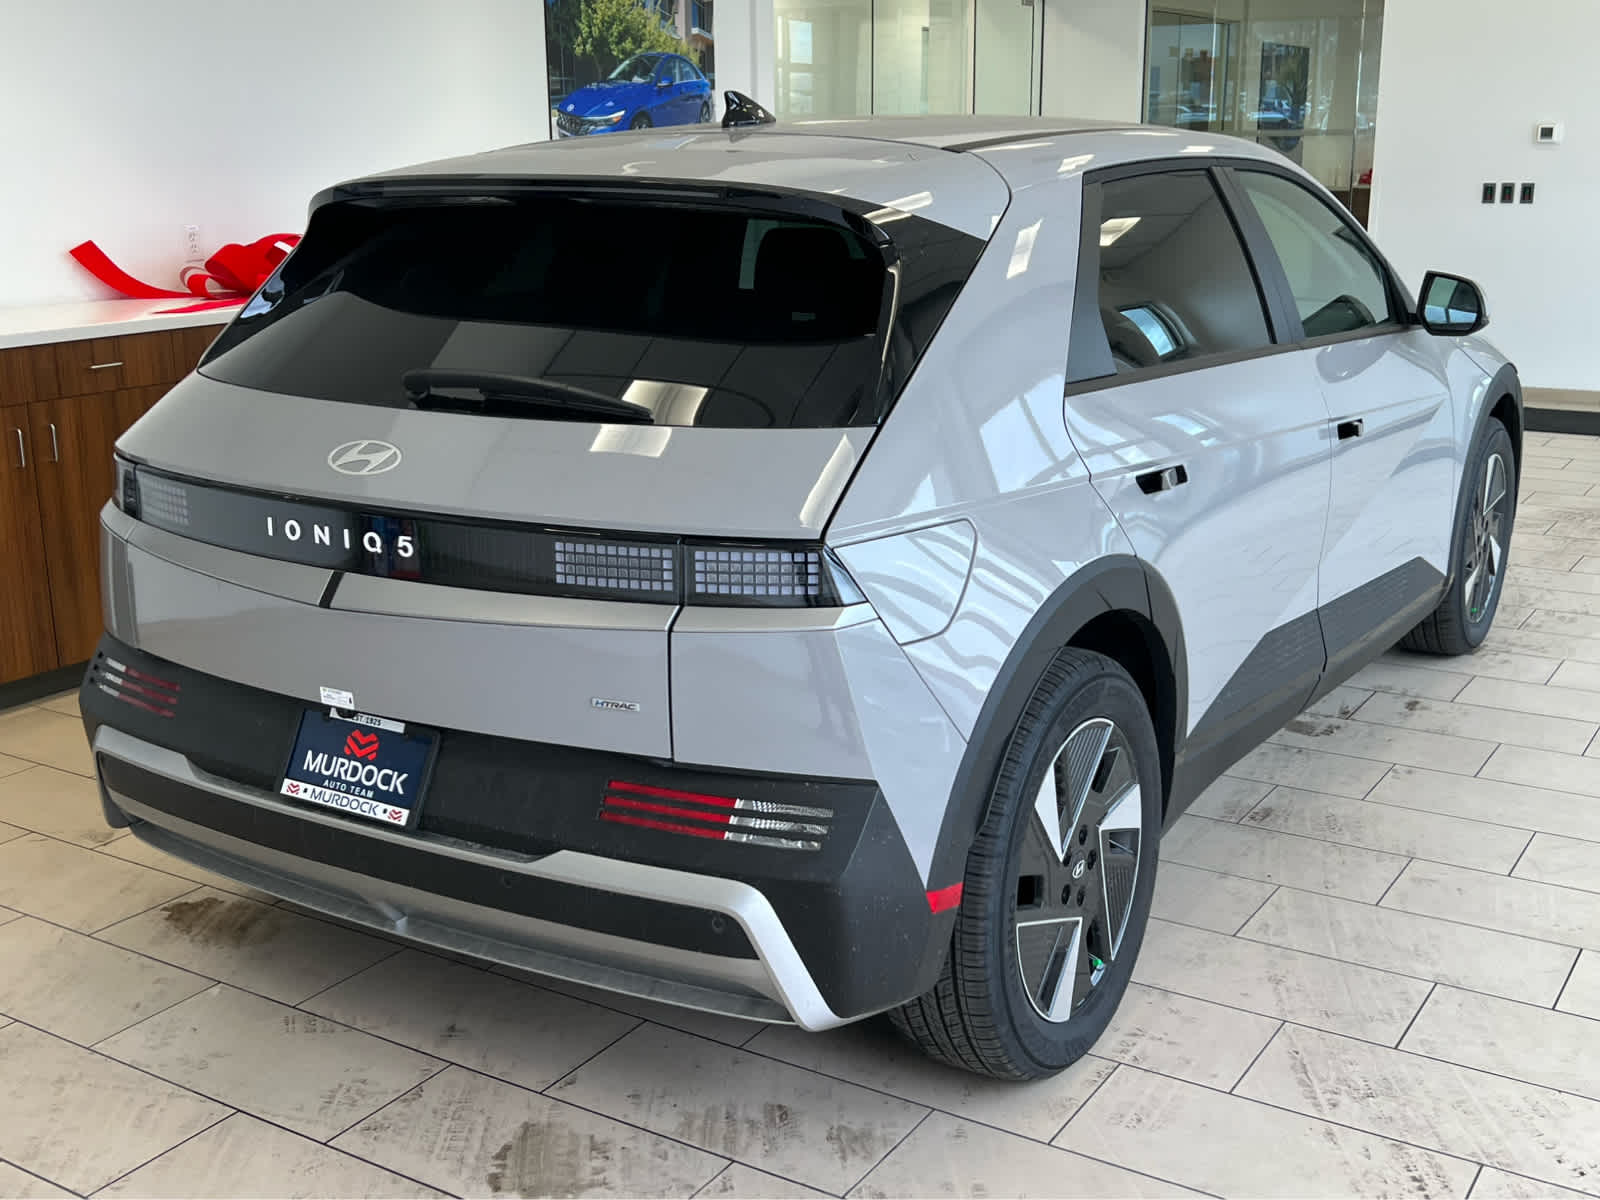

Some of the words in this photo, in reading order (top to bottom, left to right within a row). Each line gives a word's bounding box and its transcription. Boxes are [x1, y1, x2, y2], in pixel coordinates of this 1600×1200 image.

[266, 516, 382, 554] IONIQ
[397, 535, 414, 557] 5
[594, 699, 637, 711] HTRAC
[303, 749, 408, 794] MURDOCK
[310, 787, 379, 816] MURDOCK
[323, 779, 347, 792] AUTO
[349, 786, 374, 798] TEAM
